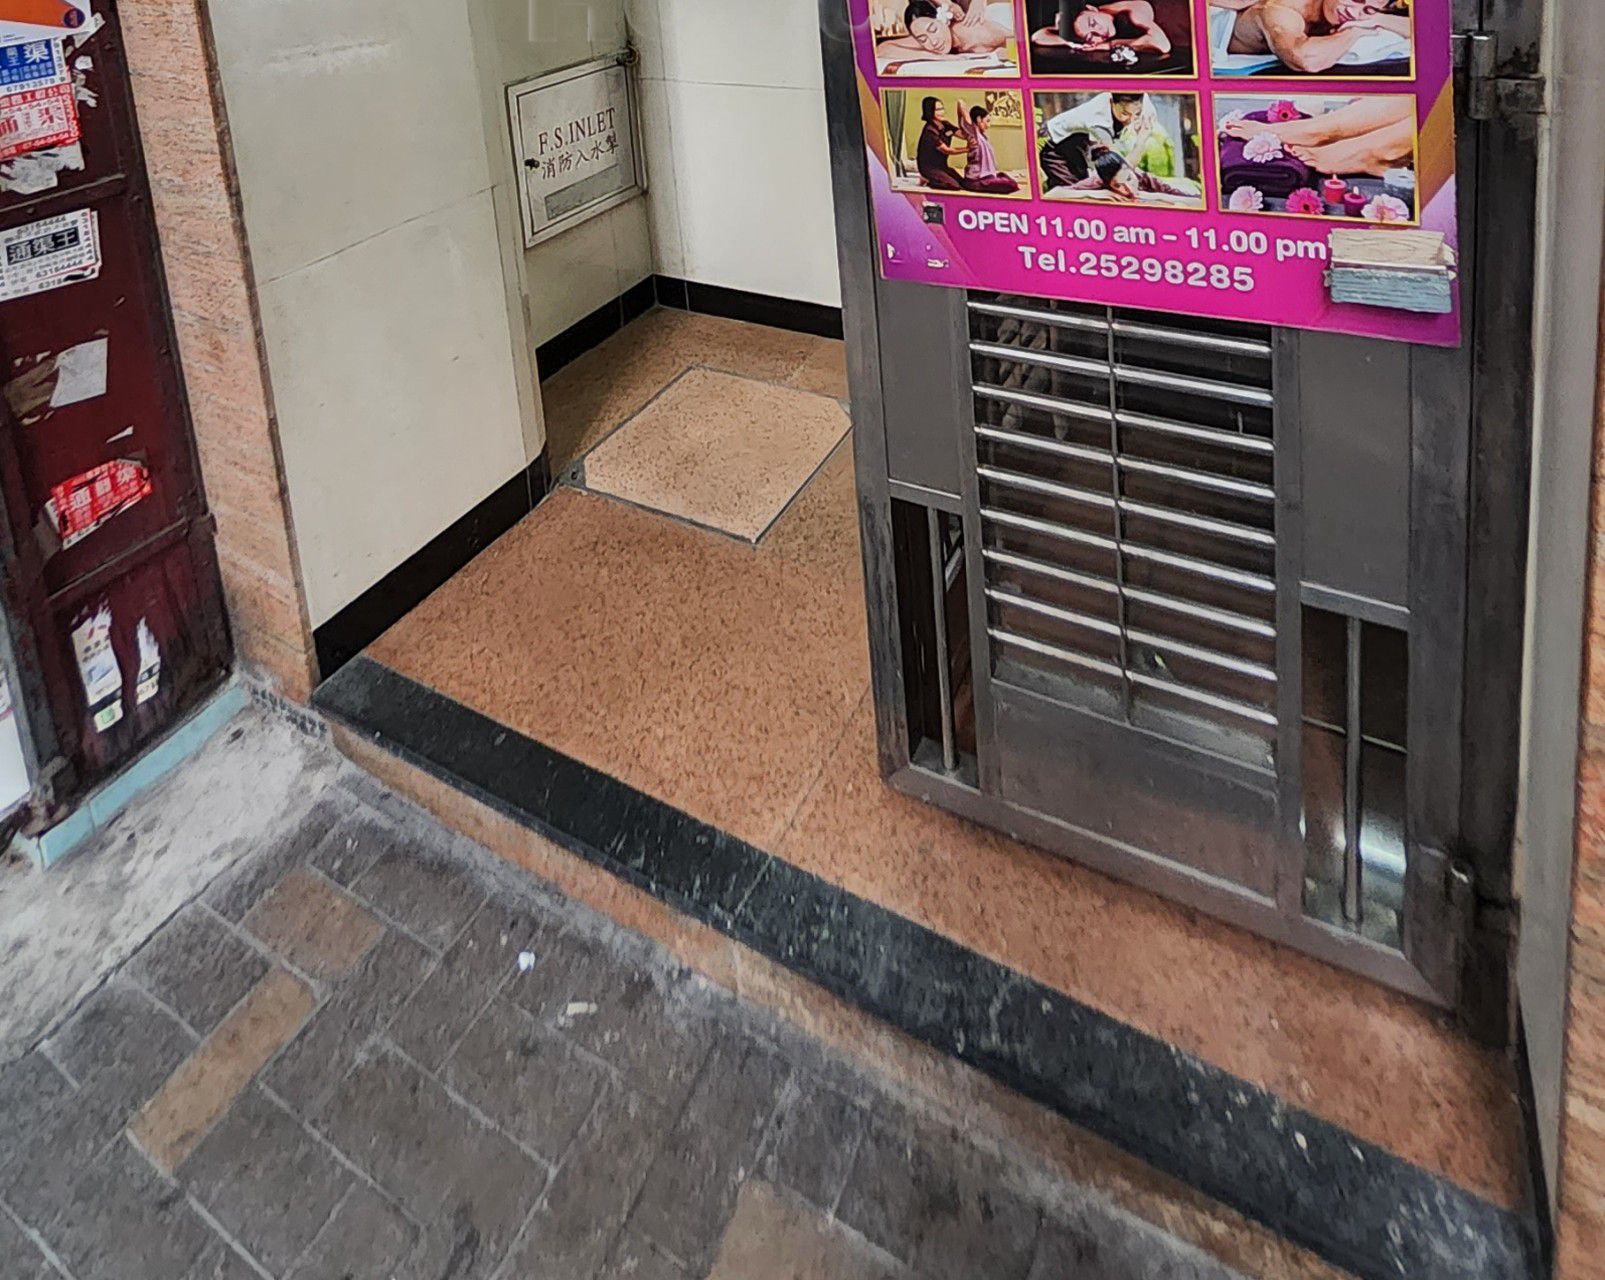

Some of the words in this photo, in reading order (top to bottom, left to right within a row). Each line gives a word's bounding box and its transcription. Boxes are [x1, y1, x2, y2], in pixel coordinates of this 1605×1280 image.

[958, 209, 1029, 235] OPEN
[1035, 216, 1108, 242] 11.00
[1113, 224, 1156, 246] am
[1185, 227, 1269, 255] 11.00
[1276, 236, 1328, 262] pm
